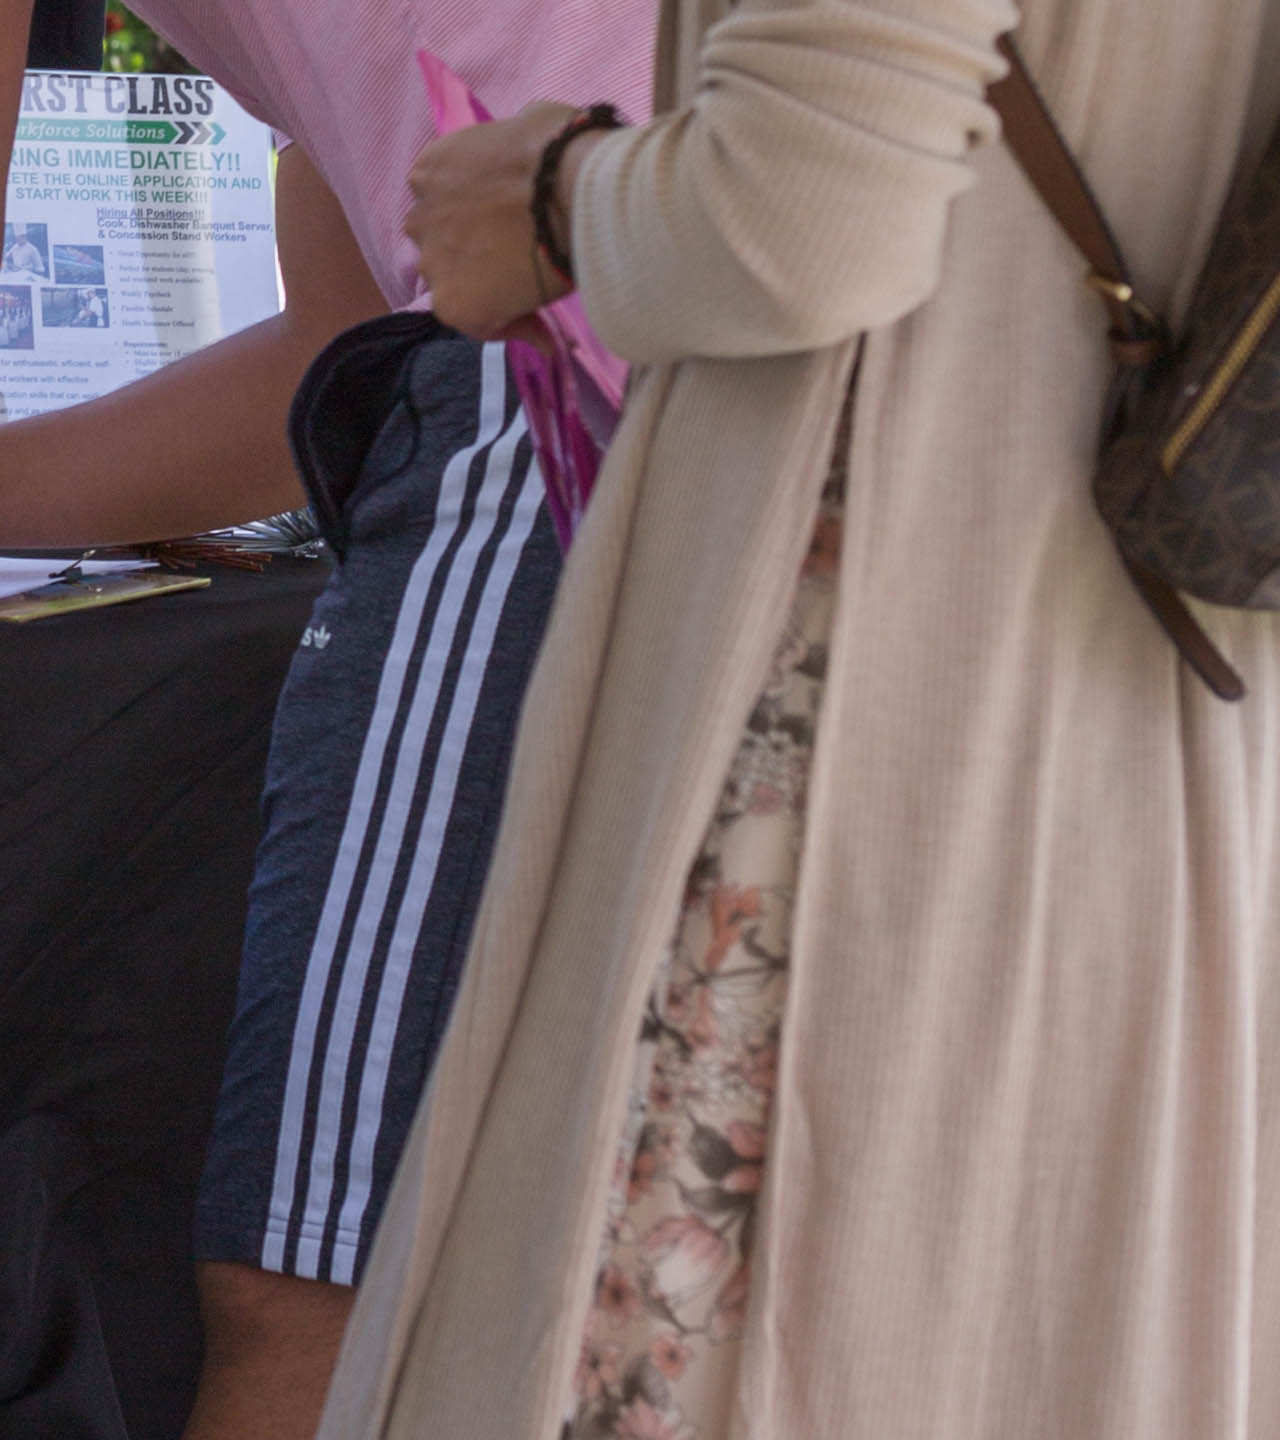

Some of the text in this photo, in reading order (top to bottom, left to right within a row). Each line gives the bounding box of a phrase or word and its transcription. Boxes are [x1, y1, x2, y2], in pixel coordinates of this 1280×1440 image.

[104, 75, 215, 116] CLASS
[16, 121, 166, 140] rkforce Solutions
[68, 149, 241, 171] IMMEDIATELY!!
[8, 172, 262, 190] ETE THE ONLINE APPLICATION AND
[16, 187, 62, 200] START
[63, 188, 111, 202] WORK
[111, 189, 148, 203] THIS
[96, 207, 128, 220] Hiring
[130, 208, 144, 219] All
